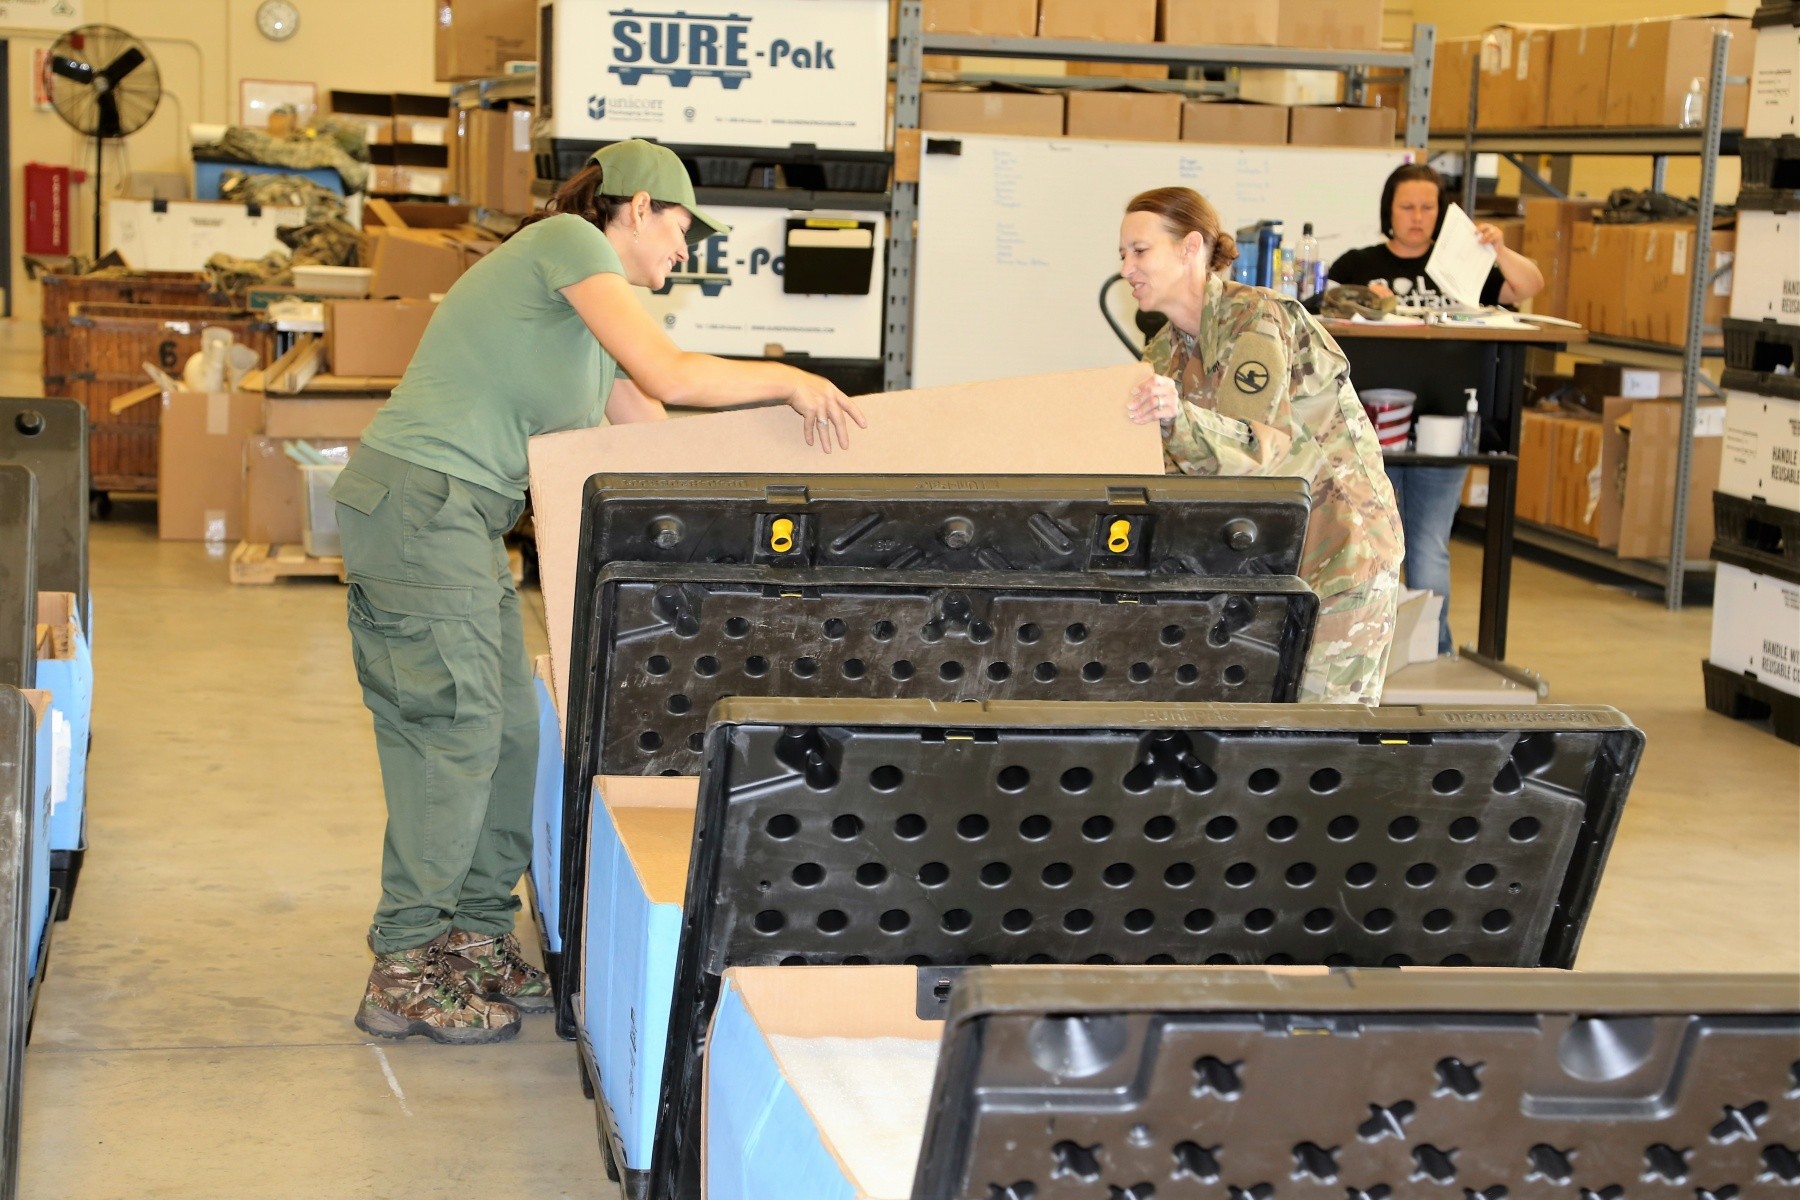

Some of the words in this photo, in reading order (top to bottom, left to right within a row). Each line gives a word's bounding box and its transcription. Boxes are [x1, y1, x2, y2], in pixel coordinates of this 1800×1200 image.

[1772, 446, 1798, 466] HANDLE
[1771, 464, 1800, 485] REUSABLE
[1762, 639, 1788, 661] HANDLE
[1762, 656, 1790, 680] REUSABLE
